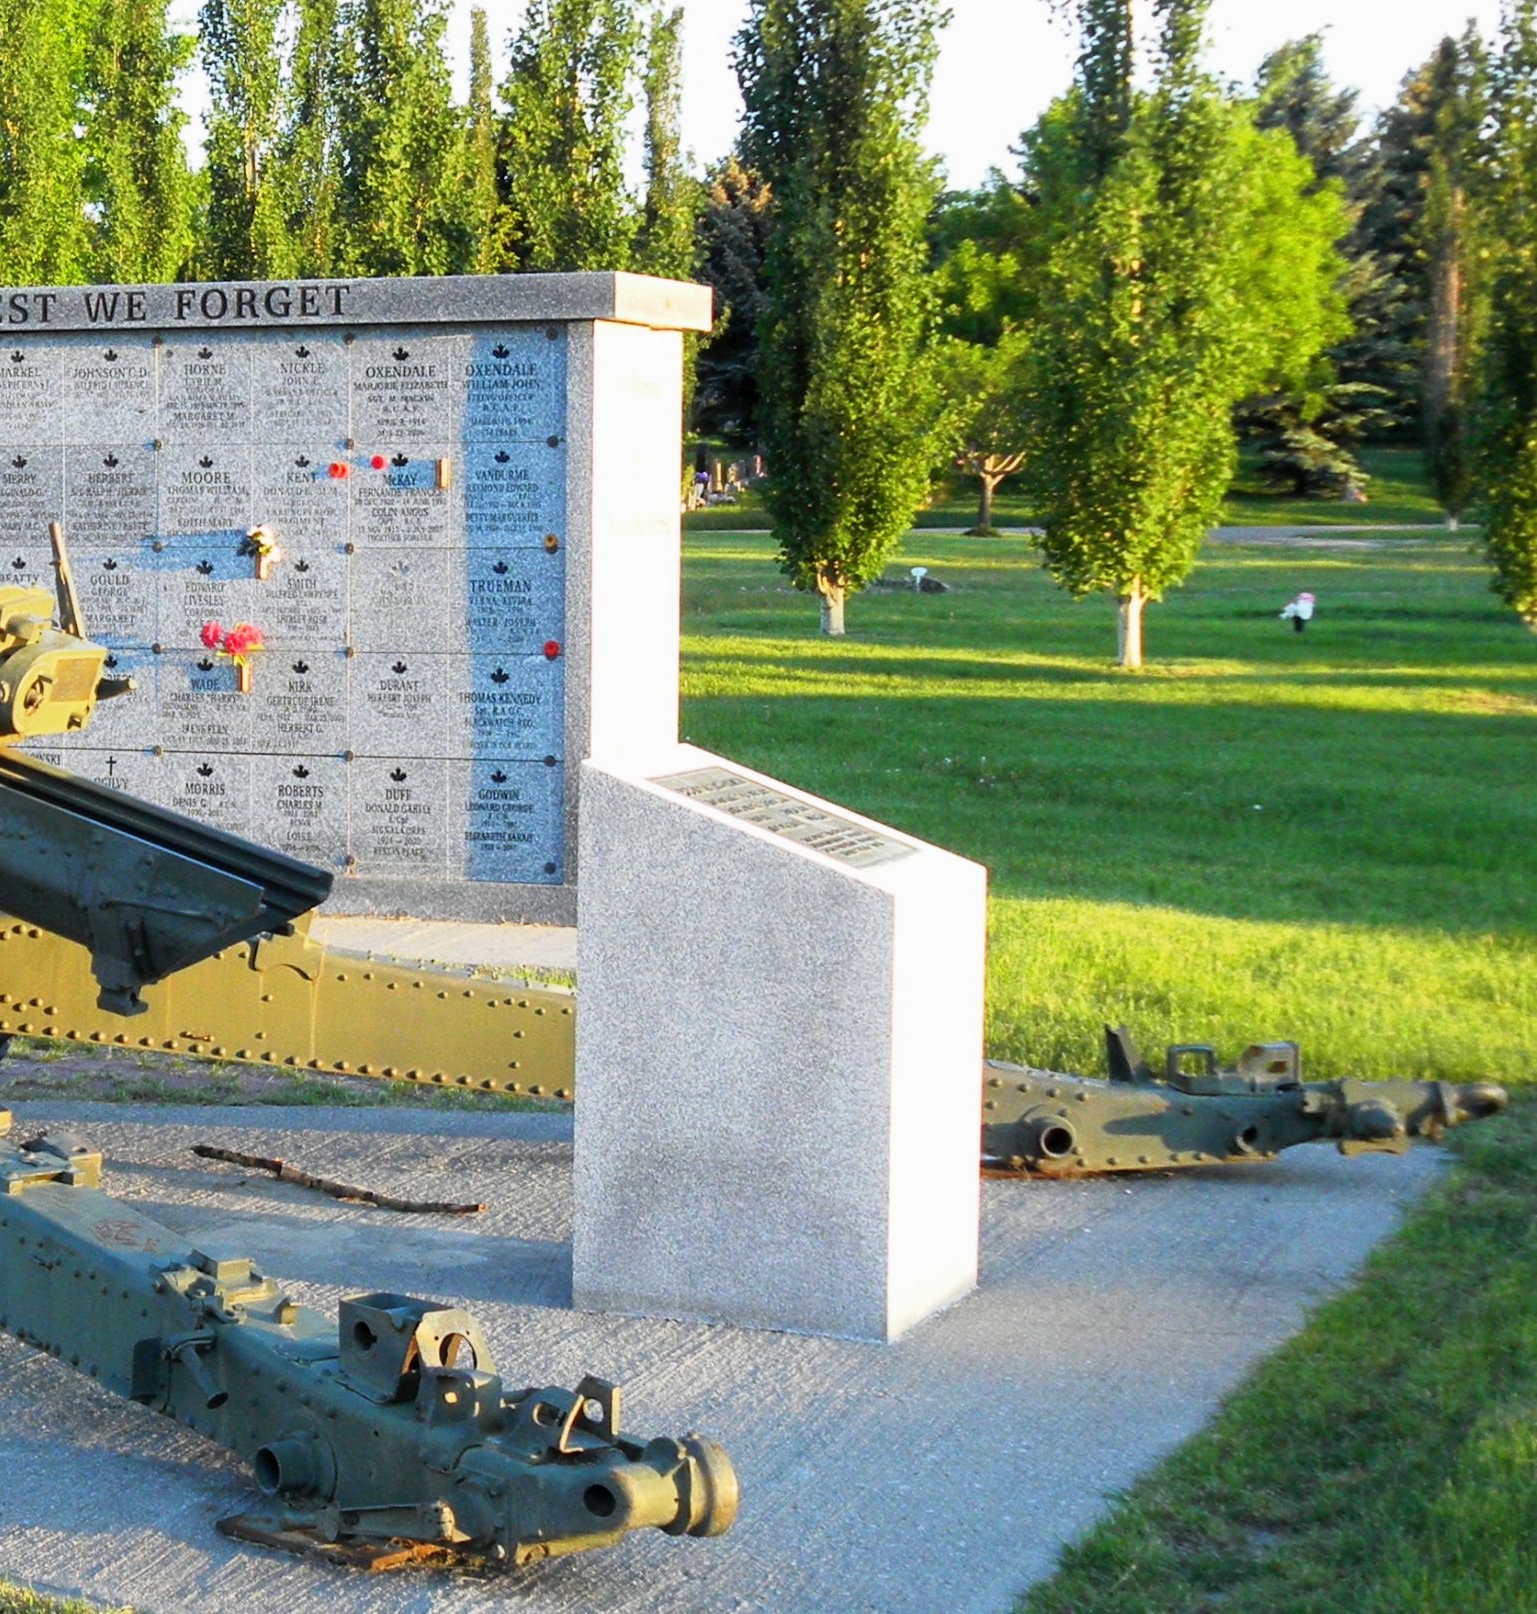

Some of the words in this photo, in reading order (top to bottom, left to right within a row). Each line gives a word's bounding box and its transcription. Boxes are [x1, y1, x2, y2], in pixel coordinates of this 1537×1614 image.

[83, 291, 147, 322] WE
[174, 285, 351, 320] FORGET
[73, 368, 126, 379] JOHNSON
[184, 364, 226, 375] HORNE
[280, 363, 325, 374] NICKLE
[365, 366, 436, 377] OXENDALE
[465, 363, 537, 376] OXENDALE
[3, 473, 36, 484] MERRY
[88, 473, 135, 484] HERBERT
[181, 472, 231, 484] MOORE
[286, 472, 317, 483] KENT
[383, 473, 417, 486] McKAY
[372, 508, 397, 516] COLIN
[401, 508, 429, 516] ANGUS
[90, 575, 130, 585] GOULD
[287, 579, 317, 589] SMITH
[185, 582, 225, 592] EDWARD
[470, 580, 532, 593] TRUEMAN
[91, 588, 128, 597] GEORGE
[86, 614, 136, 623] MARGARET
[191, 679, 219, 690] WADE
[288, 681, 312, 692] KIRK
[380, 680, 419, 691] DURANT
[460, 692, 498, 705] THOMAS
[499, 692, 541, 705] KENNEDY
[185, 783, 225, 795] MORRIS
[278, 785, 324, 798] ROBERTS
[479, 788, 520, 800] GODWIN
[385, 789, 412, 801] DUFF
[277, 800, 313, 810] CHARLES
[365, 804, 399, 814] DONALD
[502, 803, 534, 813] GEORGE
